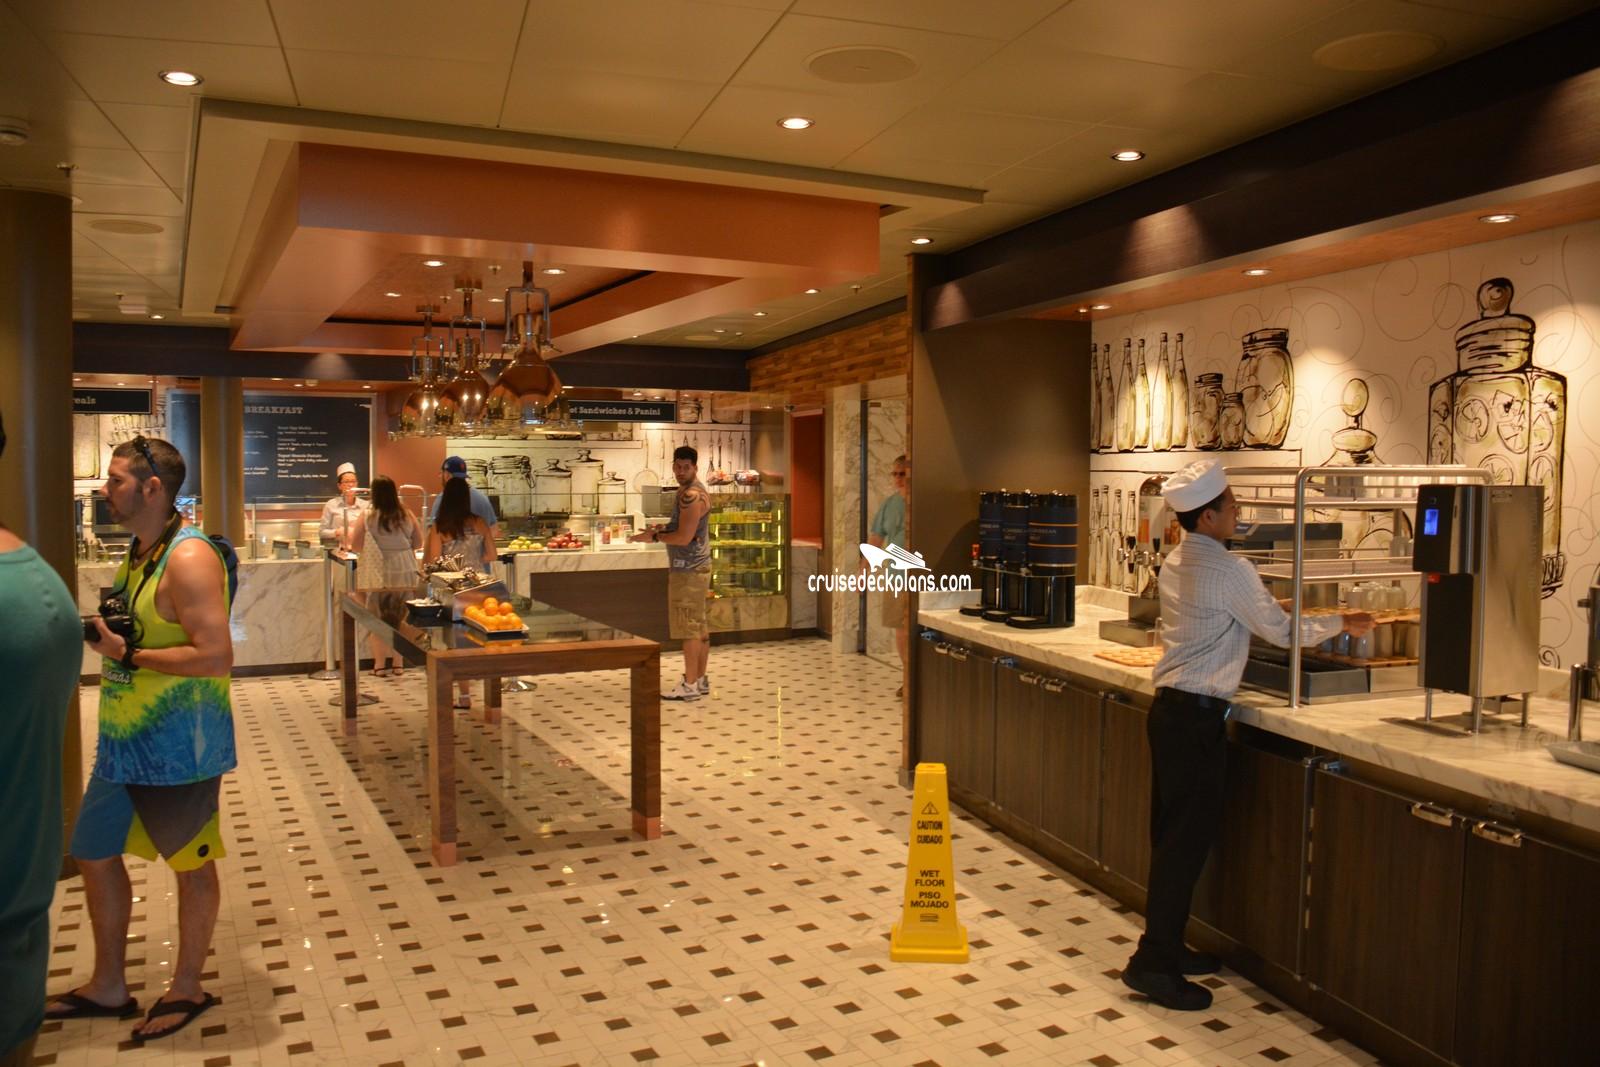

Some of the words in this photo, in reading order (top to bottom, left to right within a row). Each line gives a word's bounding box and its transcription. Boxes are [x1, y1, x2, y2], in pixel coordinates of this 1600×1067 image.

[244, 406, 304, 414] BREAKFAST
[579, 406, 627, 415] Sandwiches
[634, 407, 661, 416] Panini
[917, 820, 943, 830] CAUTION
[917, 834, 943, 844] CUIDADO
[920, 869, 940, 878] WET
[915, 879, 945, 887] FLOOR
[919, 890, 941, 899] PISO
[911, 900, 949, 909] MOJADO
